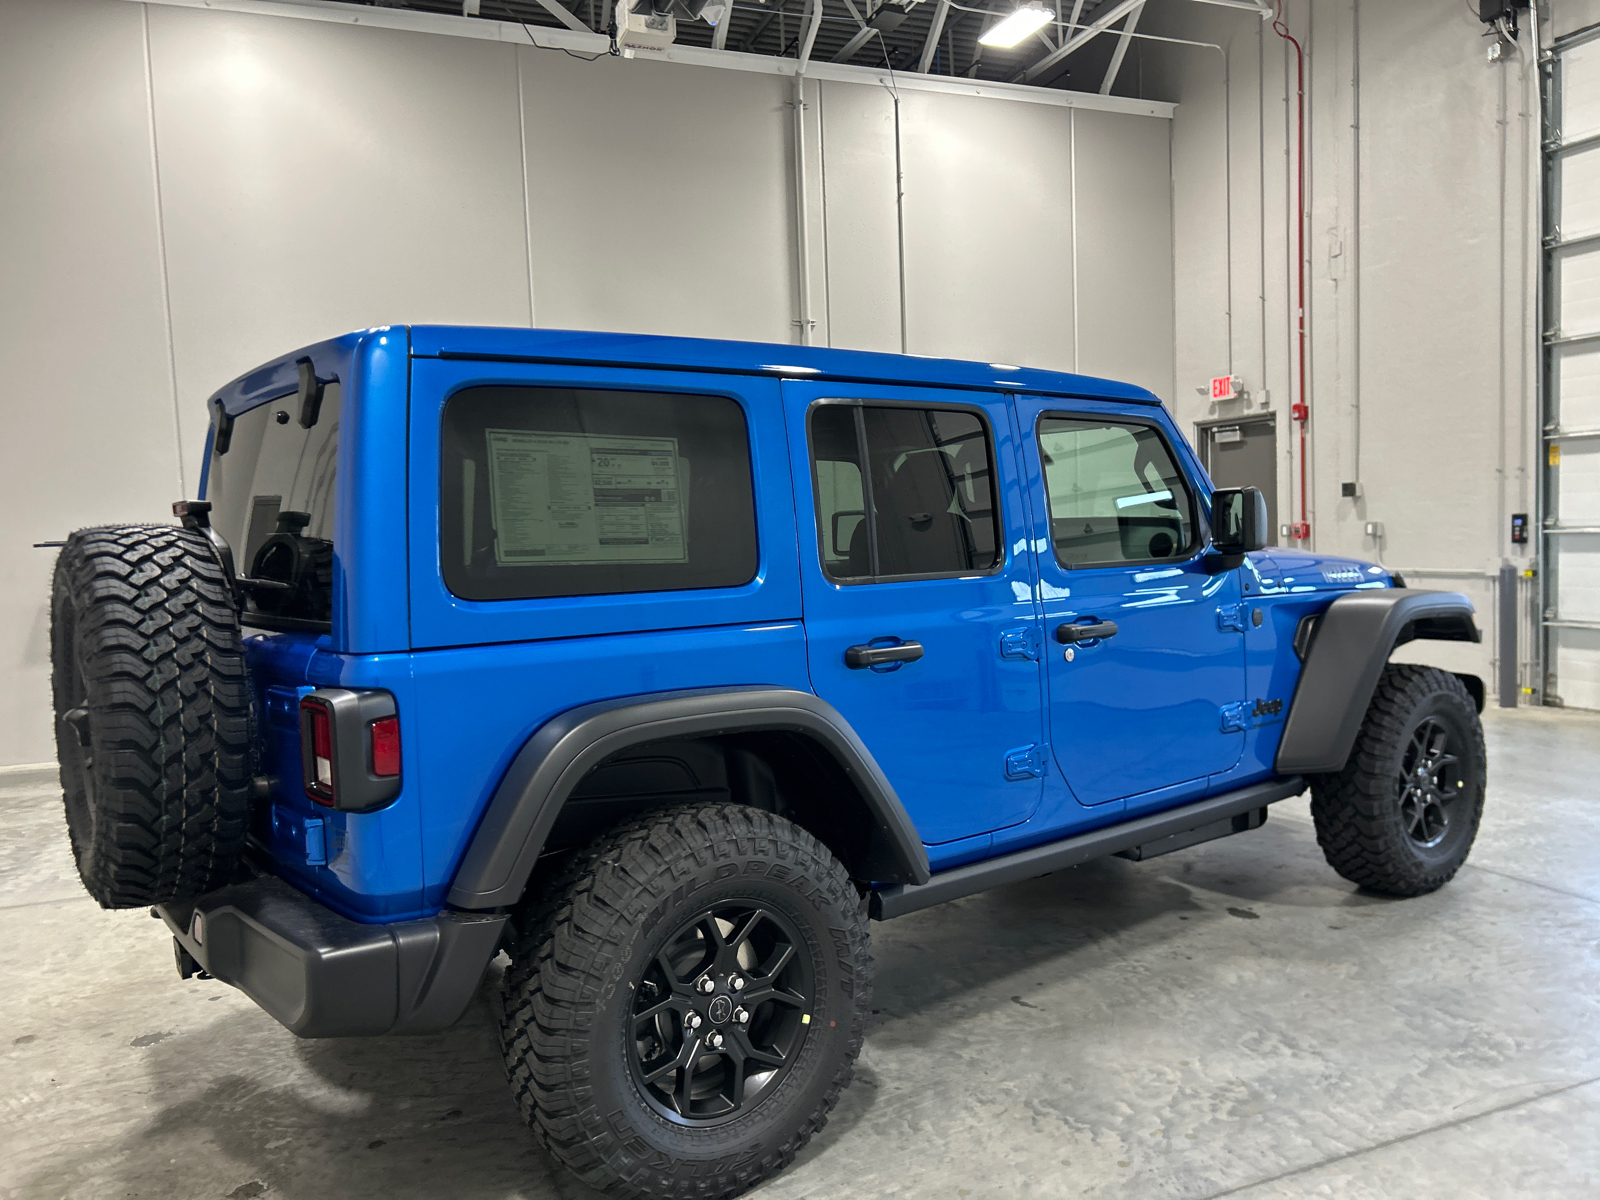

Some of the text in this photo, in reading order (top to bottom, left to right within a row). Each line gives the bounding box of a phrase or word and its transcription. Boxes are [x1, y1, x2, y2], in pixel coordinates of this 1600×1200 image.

[1213, 376, 1231, 398] EXIT
[597, 457, 610, 467] 20
[1252, 698, 1283, 718] Jeep
[828, 926, 854, 999] M/T
